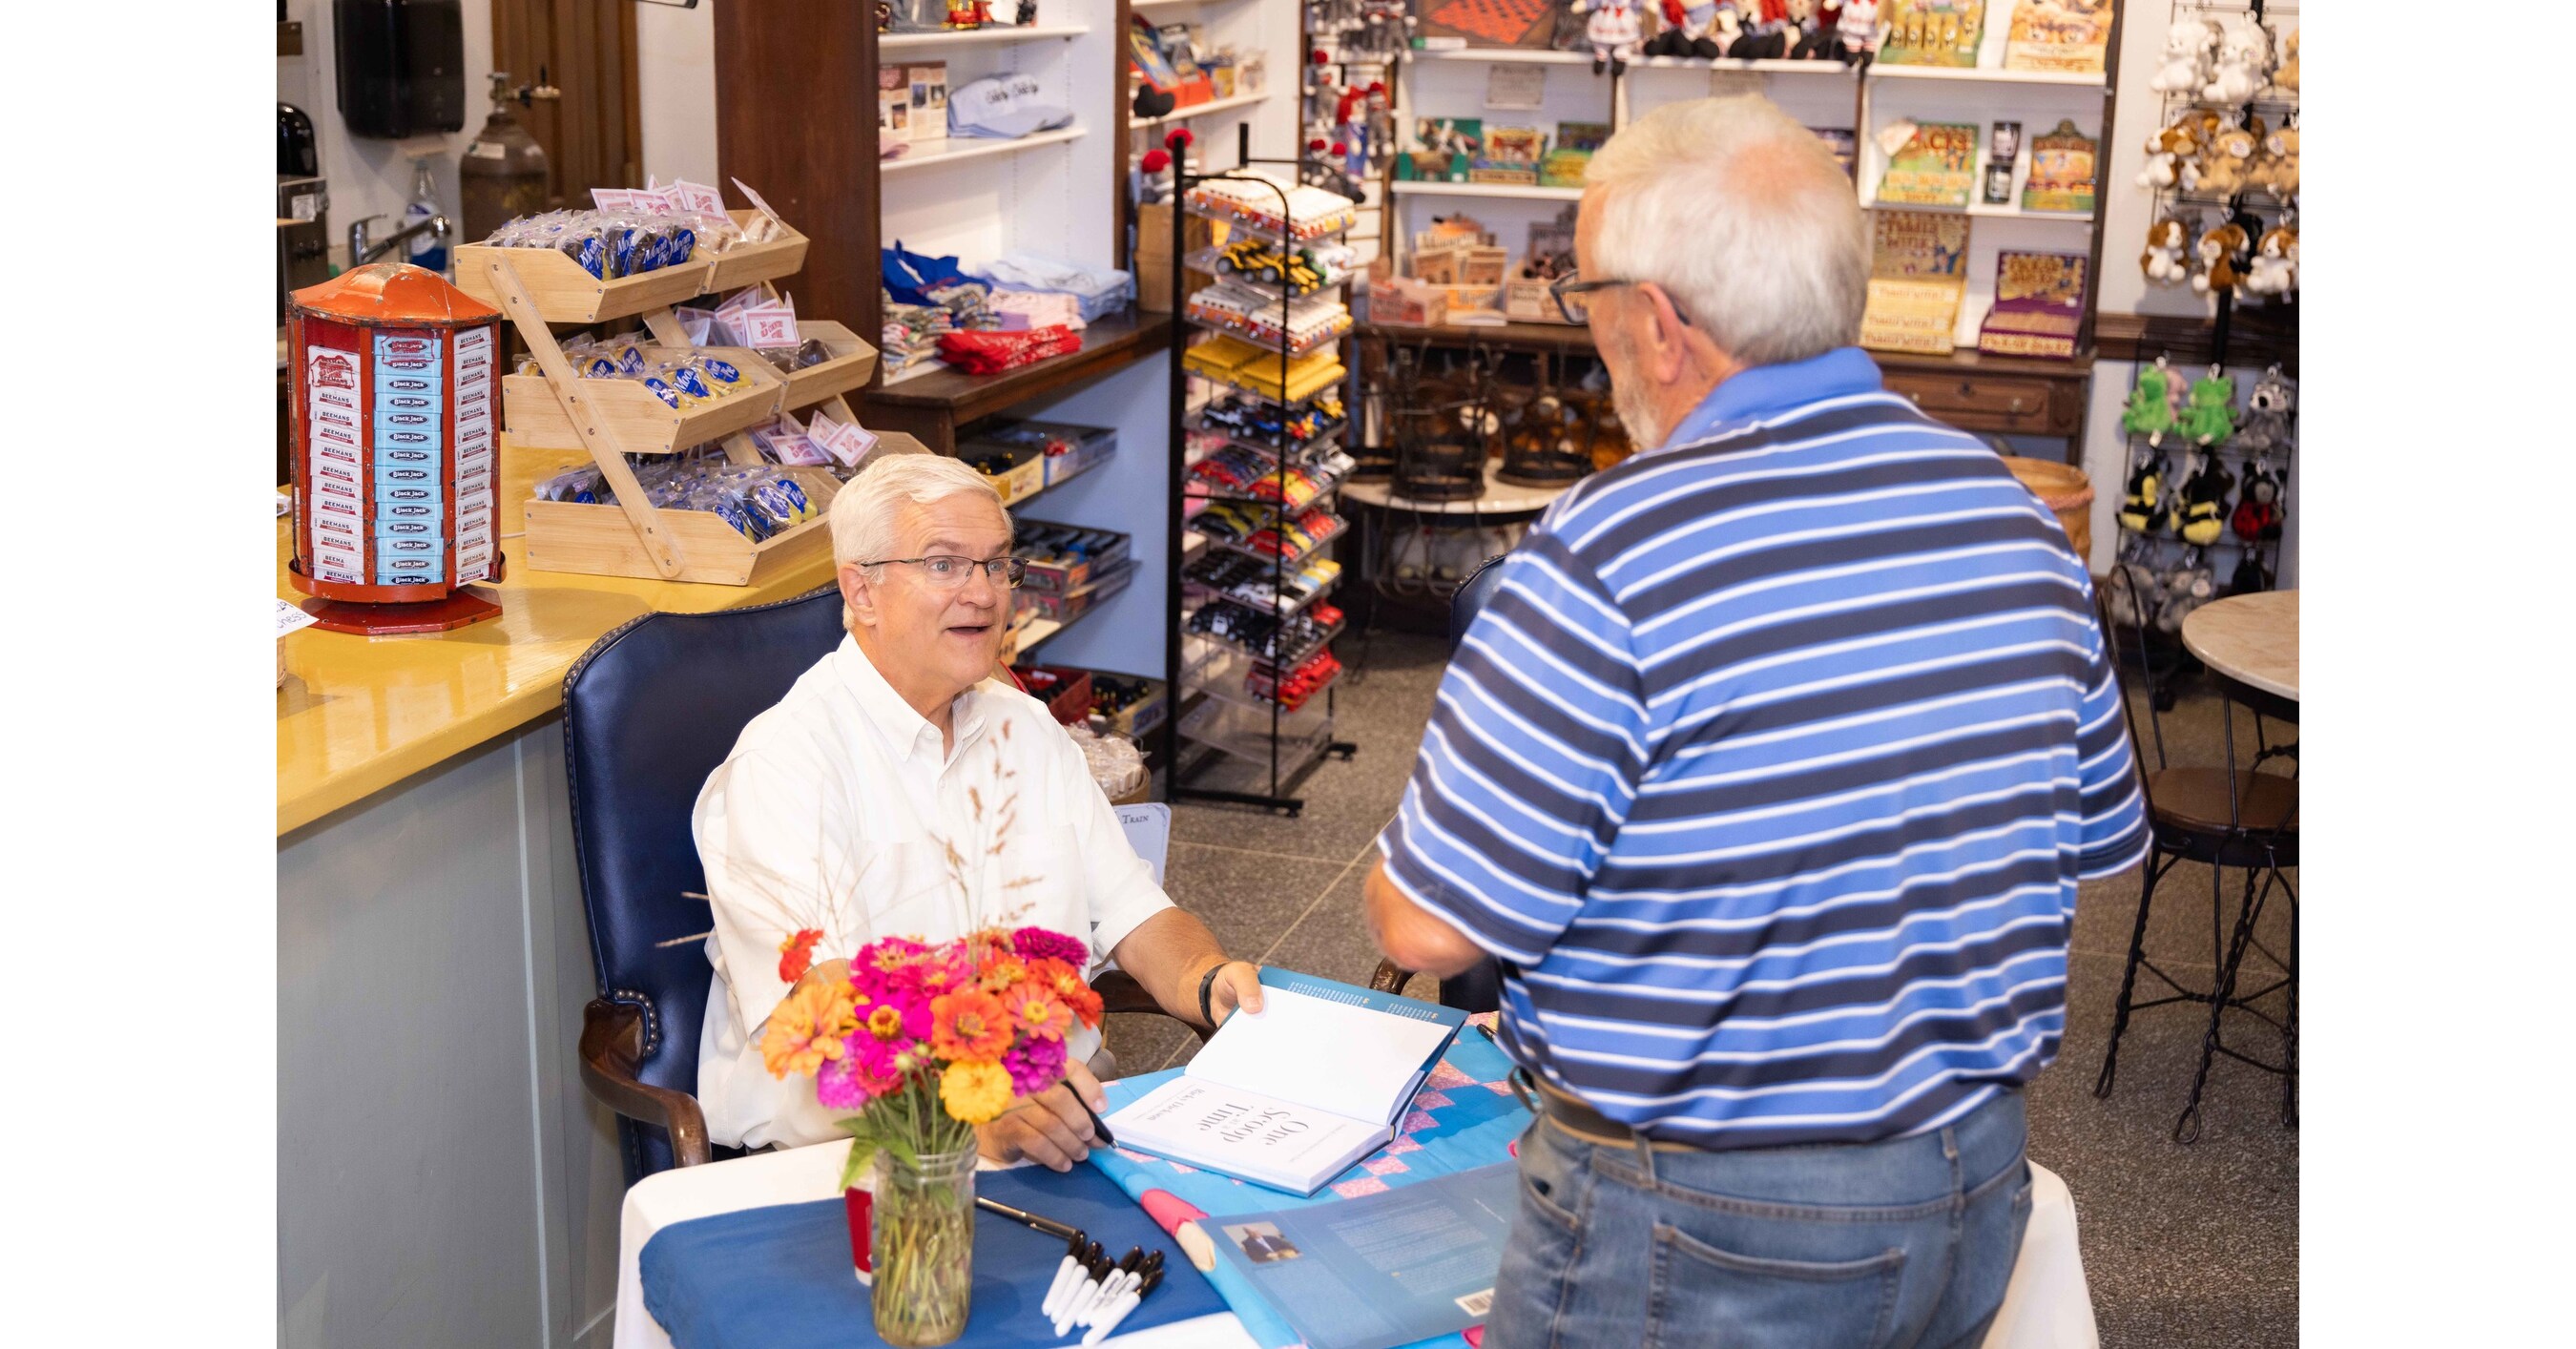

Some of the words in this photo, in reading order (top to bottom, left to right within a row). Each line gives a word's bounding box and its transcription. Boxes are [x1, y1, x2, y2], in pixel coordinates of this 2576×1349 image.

[460, 333, 482, 344] BEEMANS
[463, 356, 484, 364] BEEMANS
[463, 370, 483, 381] BEEMANS
[322, 393, 350, 403] BEEMANS
[463, 390, 483, 401] BEEMANS
[322, 411, 350, 422] BEEMANS
[461, 406, 483, 417] BEEMANS
[323, 427, 351, 439] BEEMANS
[464, 426, 484, 437] BEEMANS
[324, 446, 353, 458] BEEMANS
[464, 444, 484, 454] BEEMANS
[322, 466, 350, 477] BEEMANS
[464, 465, 484, 474] BEEMANS
[324, 482, 353, 493] BEEMANS
[463, 482, 484, 491] BEEMANS
[324, 500, 353, 510] BEEMANS
[465, 500, 485, 509] BEEMANS
[322, 519, 349, 529] BEEMANS
[464, 516, 484, 527] BEEMANS
[323, 536, 351, 547] BEEMANS
[464, 536, 484, 546] BEEMANS
[464, 552, 485, 563] BEEMANS
[326, 571, 353, 581] BEEMANS
[461, 569, 482, 578] BEEMANS
[1122, 814, 1149, 824] TRAIN
[1196, 1103, 1255, 1131] Time
[1219, 1107, 1292, 1143] Scoop
[1261, 1120, 1309, 1146] One
